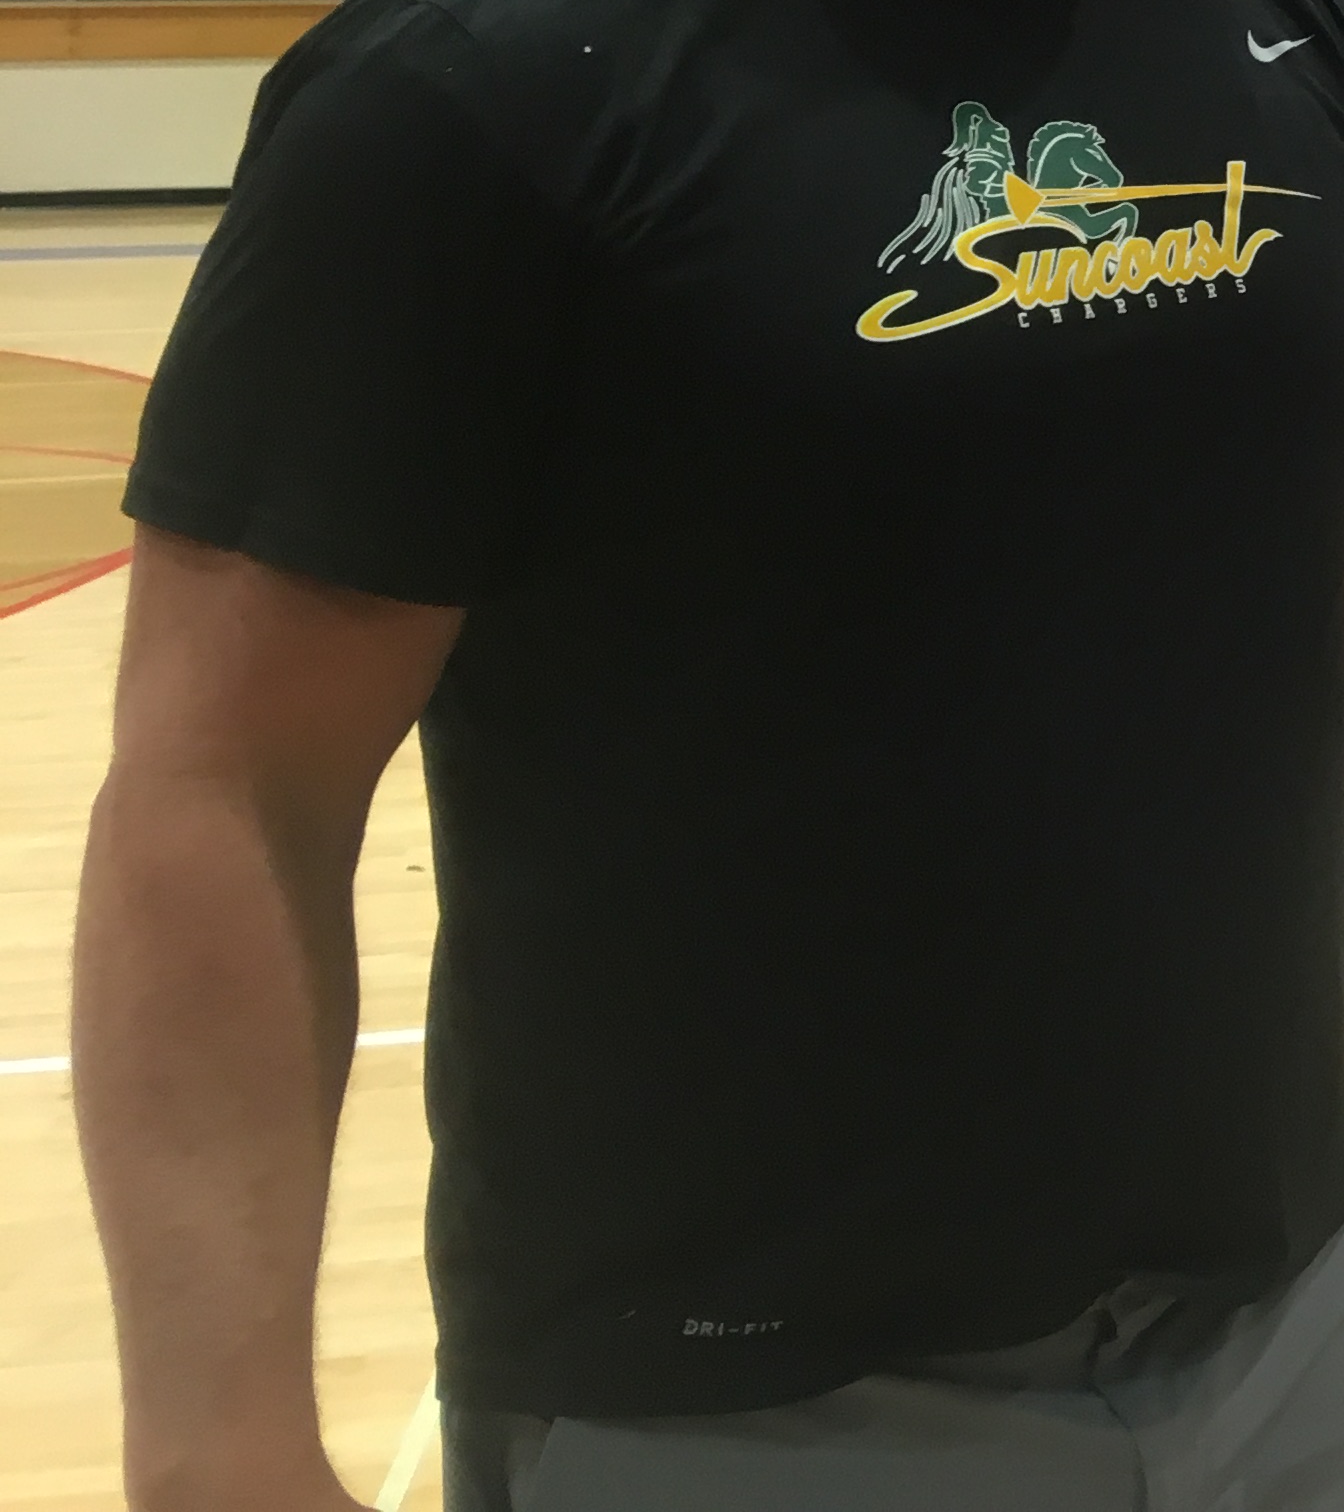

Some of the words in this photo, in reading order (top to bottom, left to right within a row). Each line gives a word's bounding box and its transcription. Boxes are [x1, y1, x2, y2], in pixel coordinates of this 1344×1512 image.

[856, 160, 1286, 342] Suncoast
[1017, 278, 1248, 329] CHARGERS
[682, 1317, 784, 1337] DRI-FIT
